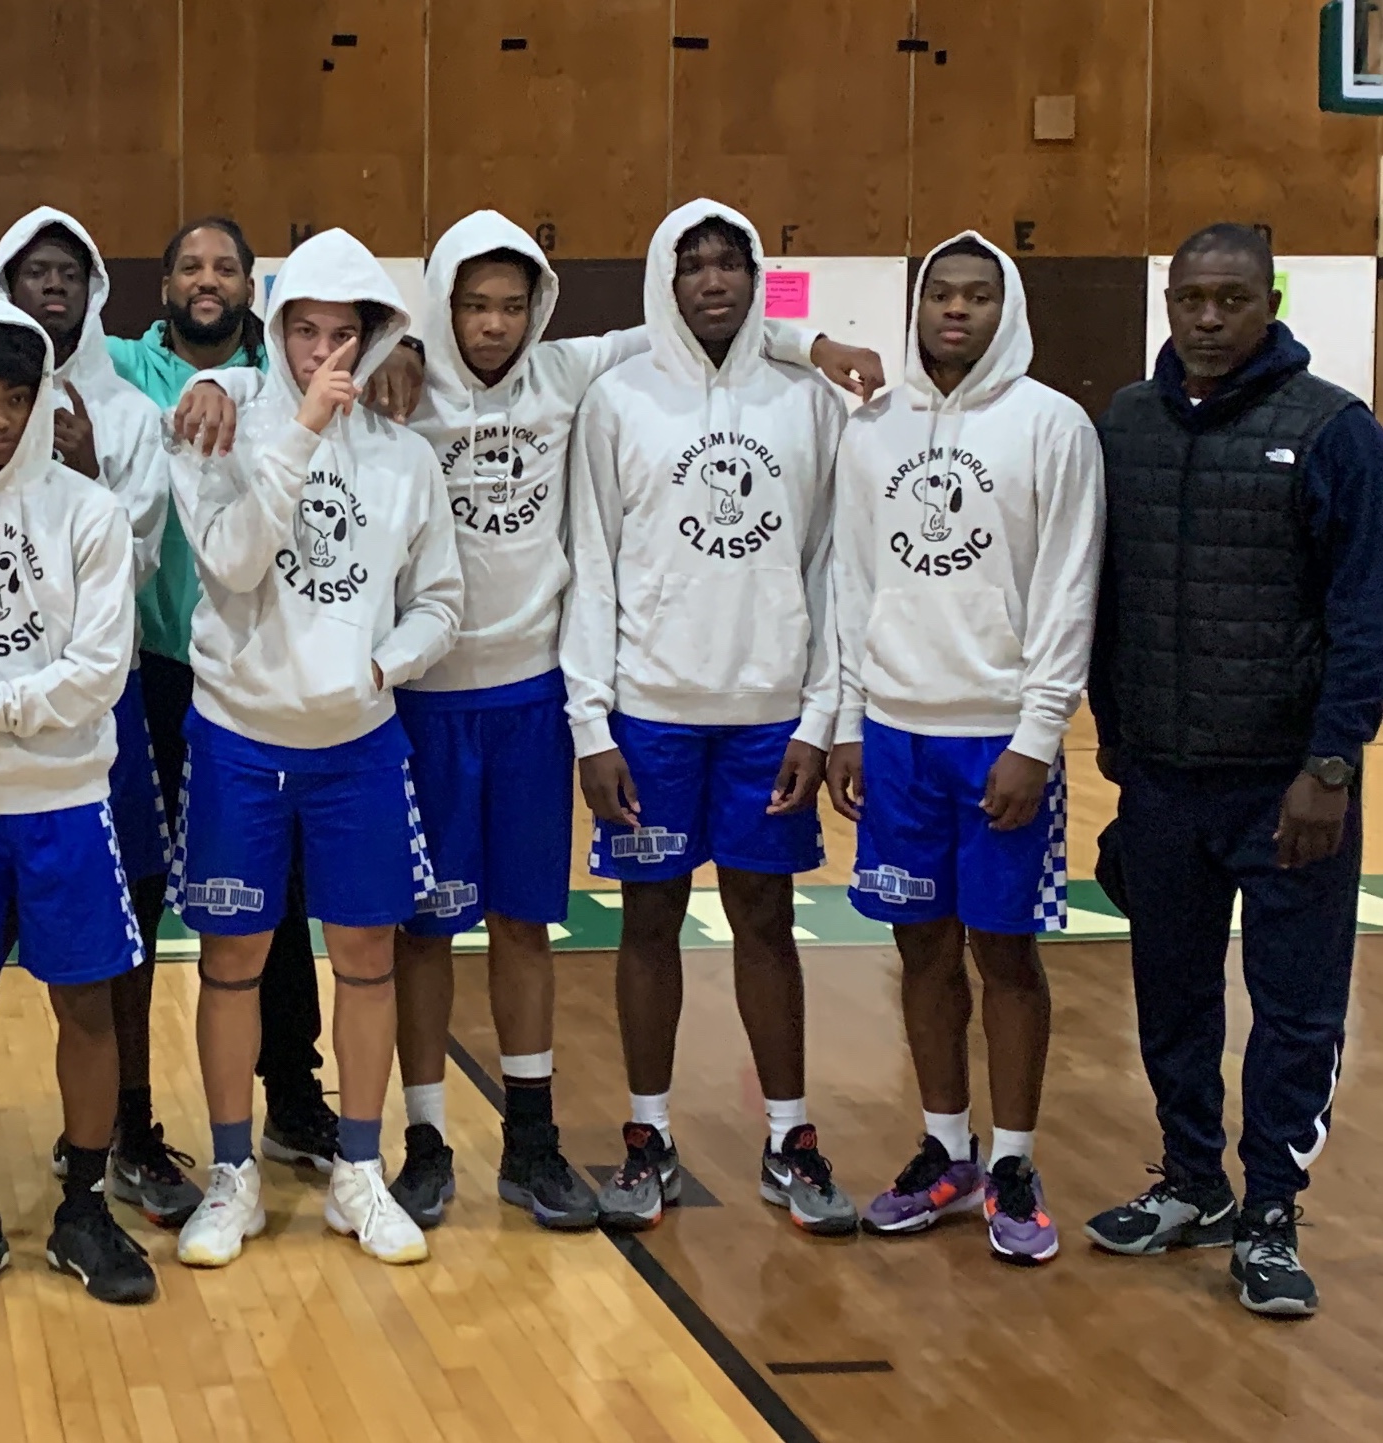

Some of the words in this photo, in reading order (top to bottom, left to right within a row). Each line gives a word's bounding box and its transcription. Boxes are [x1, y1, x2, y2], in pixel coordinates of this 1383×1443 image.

[535, 223, 556, 252] G
[781, 224, 800, 255] F
[1013, 220, 1036, 251] E
[671, 432, 726, 486] HARLEM
[729, 431, 782, 479] WORLD
[884, 447, 944, 500] HARLEM
[951, 448, 995, 494] WORLD
[450, 483, 550, 536] CLASSIC
[678, 510, 783, 560] CLASSIC
[890, 527, 993, 577] CLASSIC
[275, 548, 368, 604] CLASSIC
